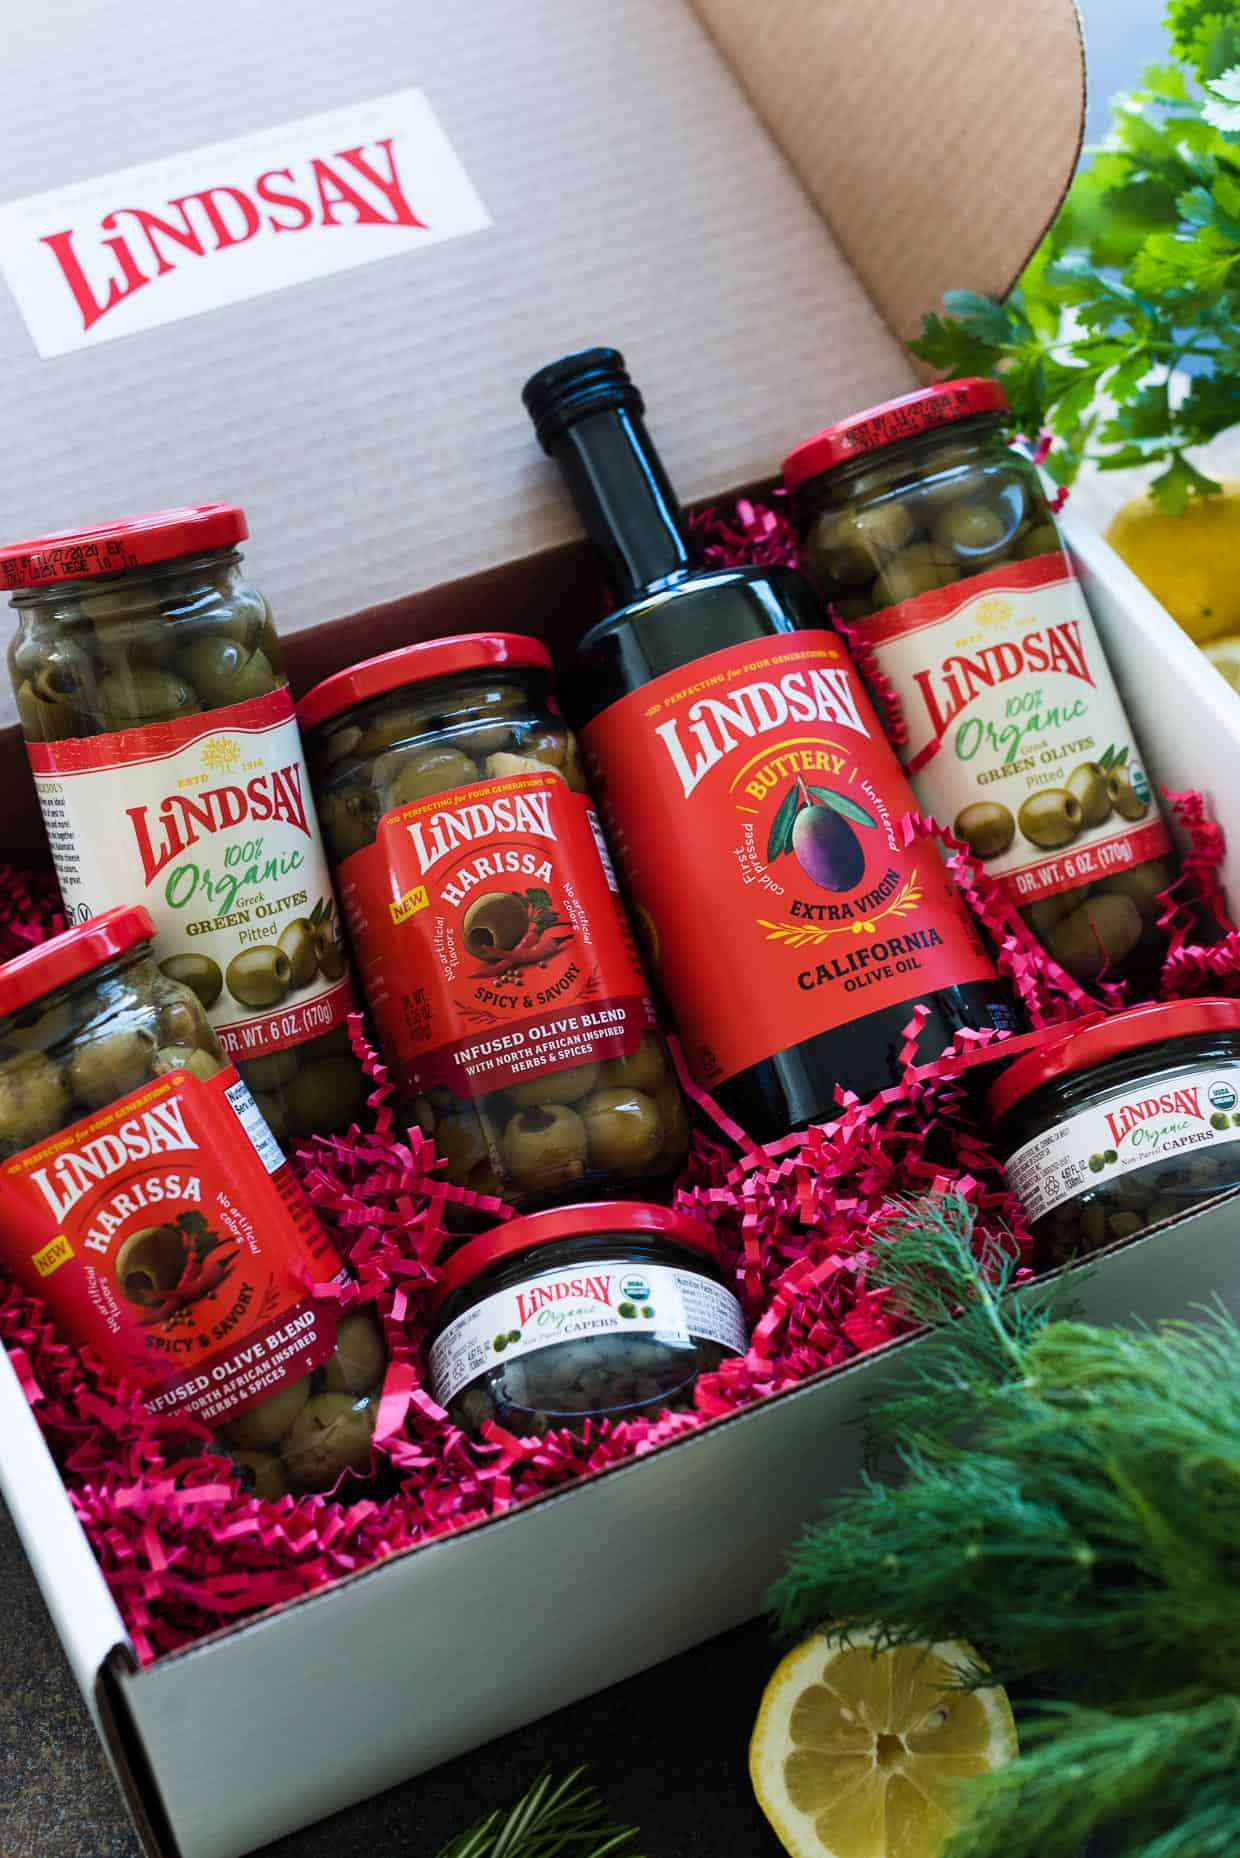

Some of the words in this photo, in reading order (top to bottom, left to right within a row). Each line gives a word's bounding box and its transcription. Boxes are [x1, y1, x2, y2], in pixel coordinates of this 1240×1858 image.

[664, 673, 724, 706] PERFECTING
[955, 698, 1088, 762] Organic
[745, 750, 846, 800] BUTTERY
[977, 759, 1036, 786] GREEN
[1040, 736, 1096, 763] OLIVES
[1025, 768, 1064, 788] Pitted
[403, 798, 452, 820] PERFECTING
[861, 780, 900, 852] unfiltered
[224, 837, 263, 868] 100%
[742, 823, 768, 873] pressed
[1064, 860, 1075, 878] 6
[165, 850, 304, 916] Organic
[440, 851, 553, 907] HARISSA
[758, 875, 785, 896] cold
[790, 900, 855, 921] EXTRA
[854, 867, 901, 913] VIRGIN
[186, 909, 250, 937] GREEN
[256, 890, 308, 918] OLIVES
[393, 891, 423, 920] NEW
[573, 896, 593, 945] artificial
[239, 921, 278, 944] Pitted
[798, 928, 944, 991] CALIFORNIA
[843, 966, 894, 993] OLIVE
[895, 957, 922, 976] OIL
[474, 987, 519, 1009] SPICY
[523, 996, 533, 1008] &
[536, 963, 581, 1005] SAVORY
[243, 1025, 269, 1047] WT.
[270, 1022, 281, 1041] 6
[303, 1003, 333, 1034] (170g)
[453, 1032, 525, 1065] INFUSED
[529, 1018, 579, 1040] OLIVE
[581, 1008, 626, 1027] BLEND
[465, 1059, 494, 1076] WITH
[495, 1047, 534, 1066] NORTH
[535, 1034, 581, 1054] AFRICAN
[583, 1025, 625, 1042] INSPIRED
[511, 1056, 547, 1073] HERBS
[549, 1053, 558, 1062] &
[559, 1044, 593, 1060] SPICES
[1131, 1119, 1192, 1148] Organic
[1162, 1130, 1214, 1151] CAPERS
[84, 1175, 201, 1253] HARISSA
[215, 1191, 231, 1209] No
[229, 1205, 261, 1255] artificial
[219, 1211, 244, 1244] colors
[37, 1241, 67, 1272] NEW
[145, 1334, 193, 1353] SPICY
[198, 1334, 210, 1347] &
[211, 1283, 254, 1340] SAVORY
[564, 1318, 618, 1333] CAPERS
[212, 1343, 266, 1381] OLIVE
[266, 1311, 316, 1350] BLEND
[223, 1359, 273, 1395] AFRICAN
[272, 1331, 317, 1365] INSPIRED
[200, 1396, 238, 1421] HERBS
[239, 1389, 249, 1401] &
[249, 1366, 286, 1395] SPICES
